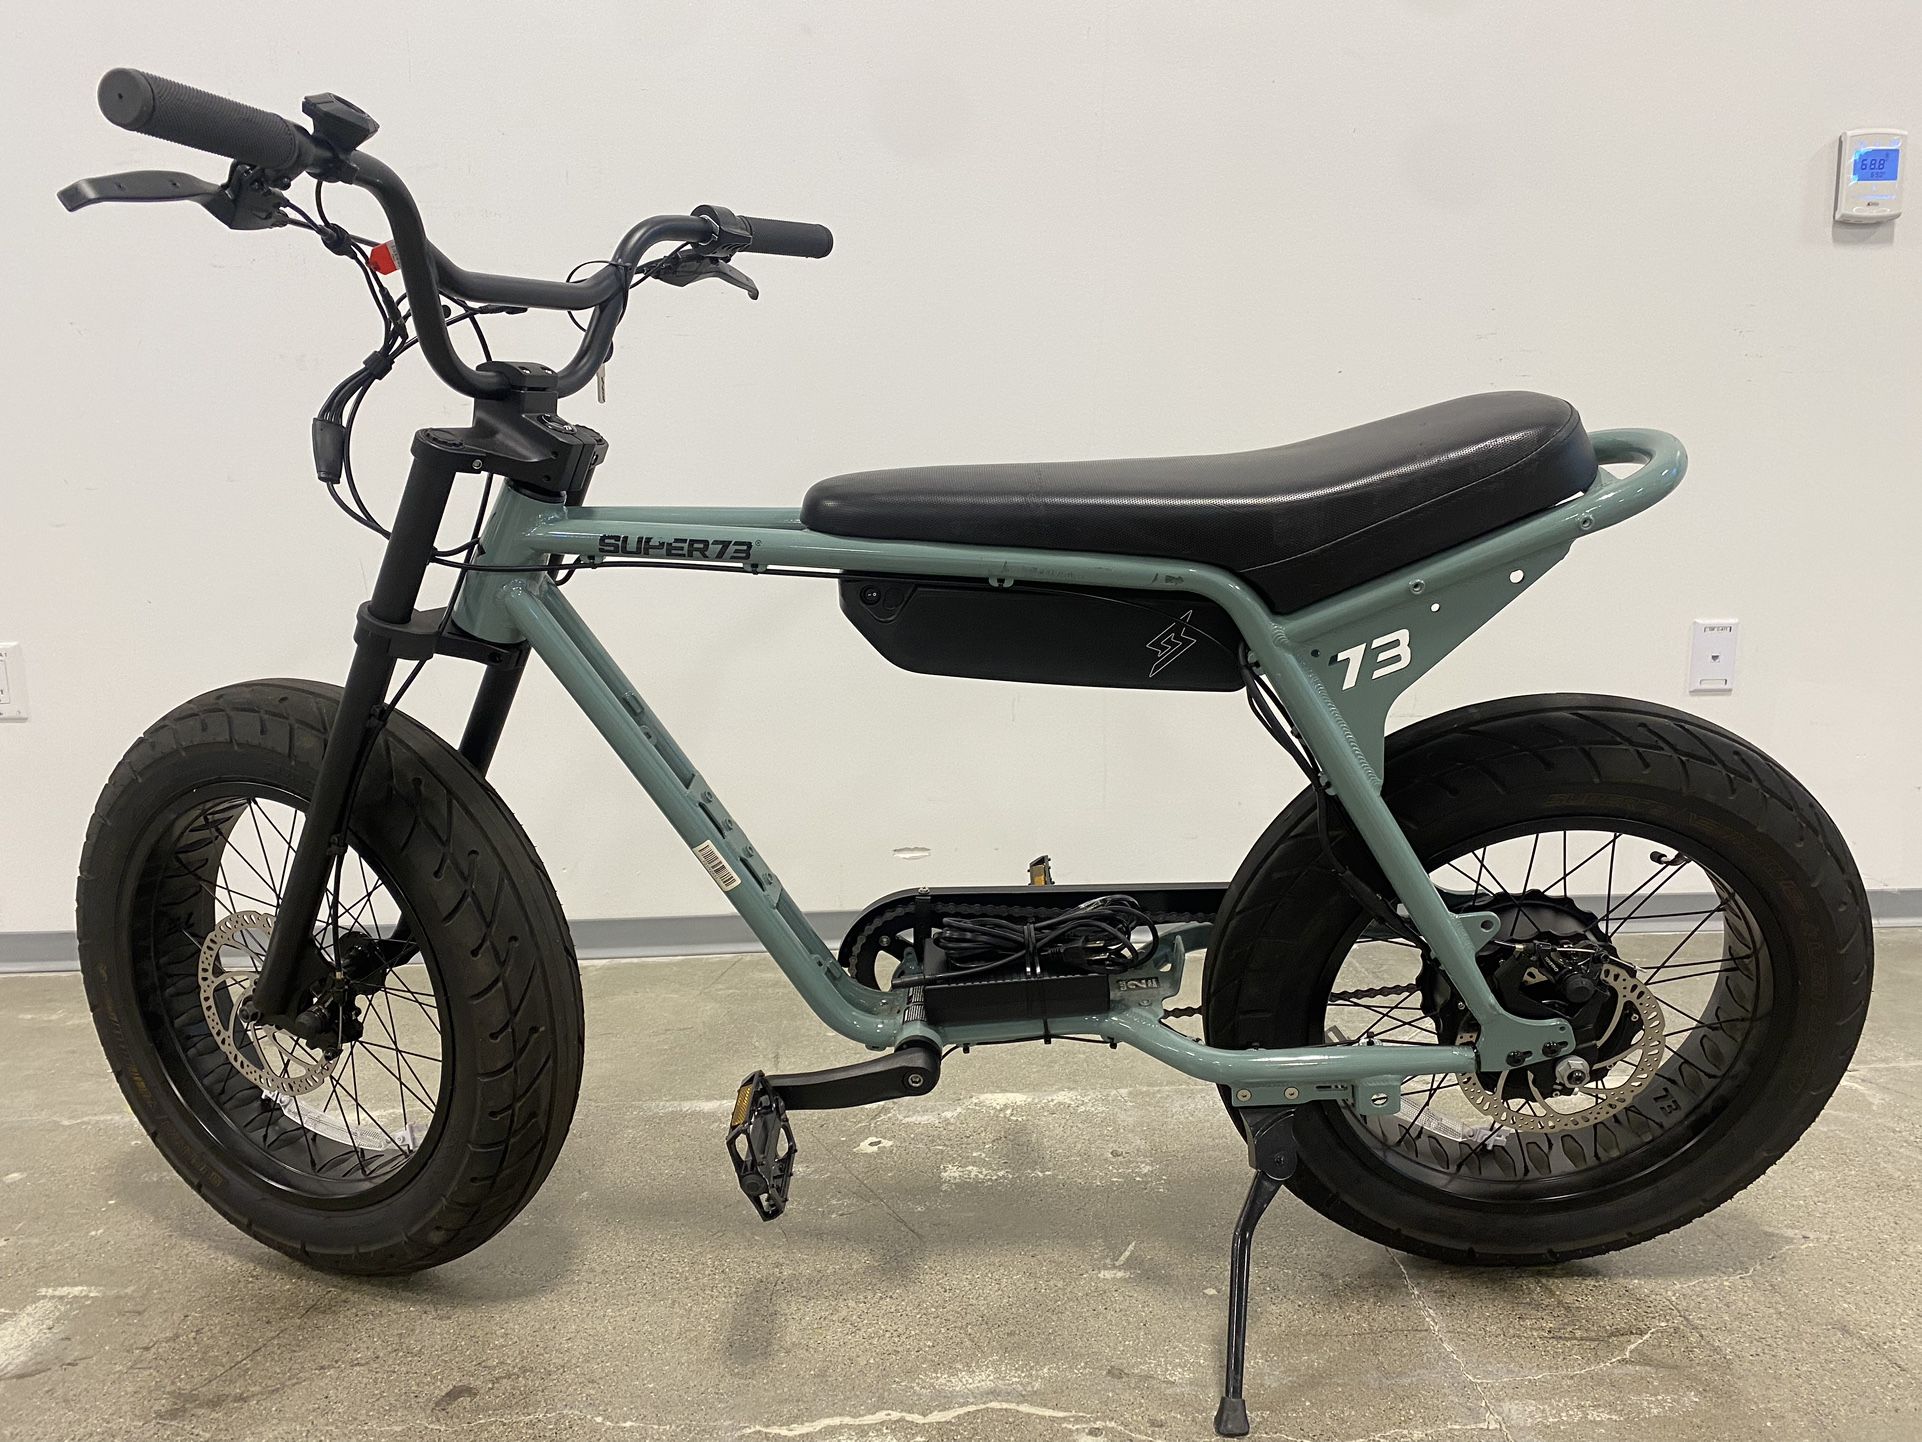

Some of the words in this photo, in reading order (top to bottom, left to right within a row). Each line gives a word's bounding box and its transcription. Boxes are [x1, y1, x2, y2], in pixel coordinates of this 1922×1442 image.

[598, 534, 753, 561] SUPER73
[1328, 628, 1412, 691] 73
[1653, 1087, 1681, 1117] 73
